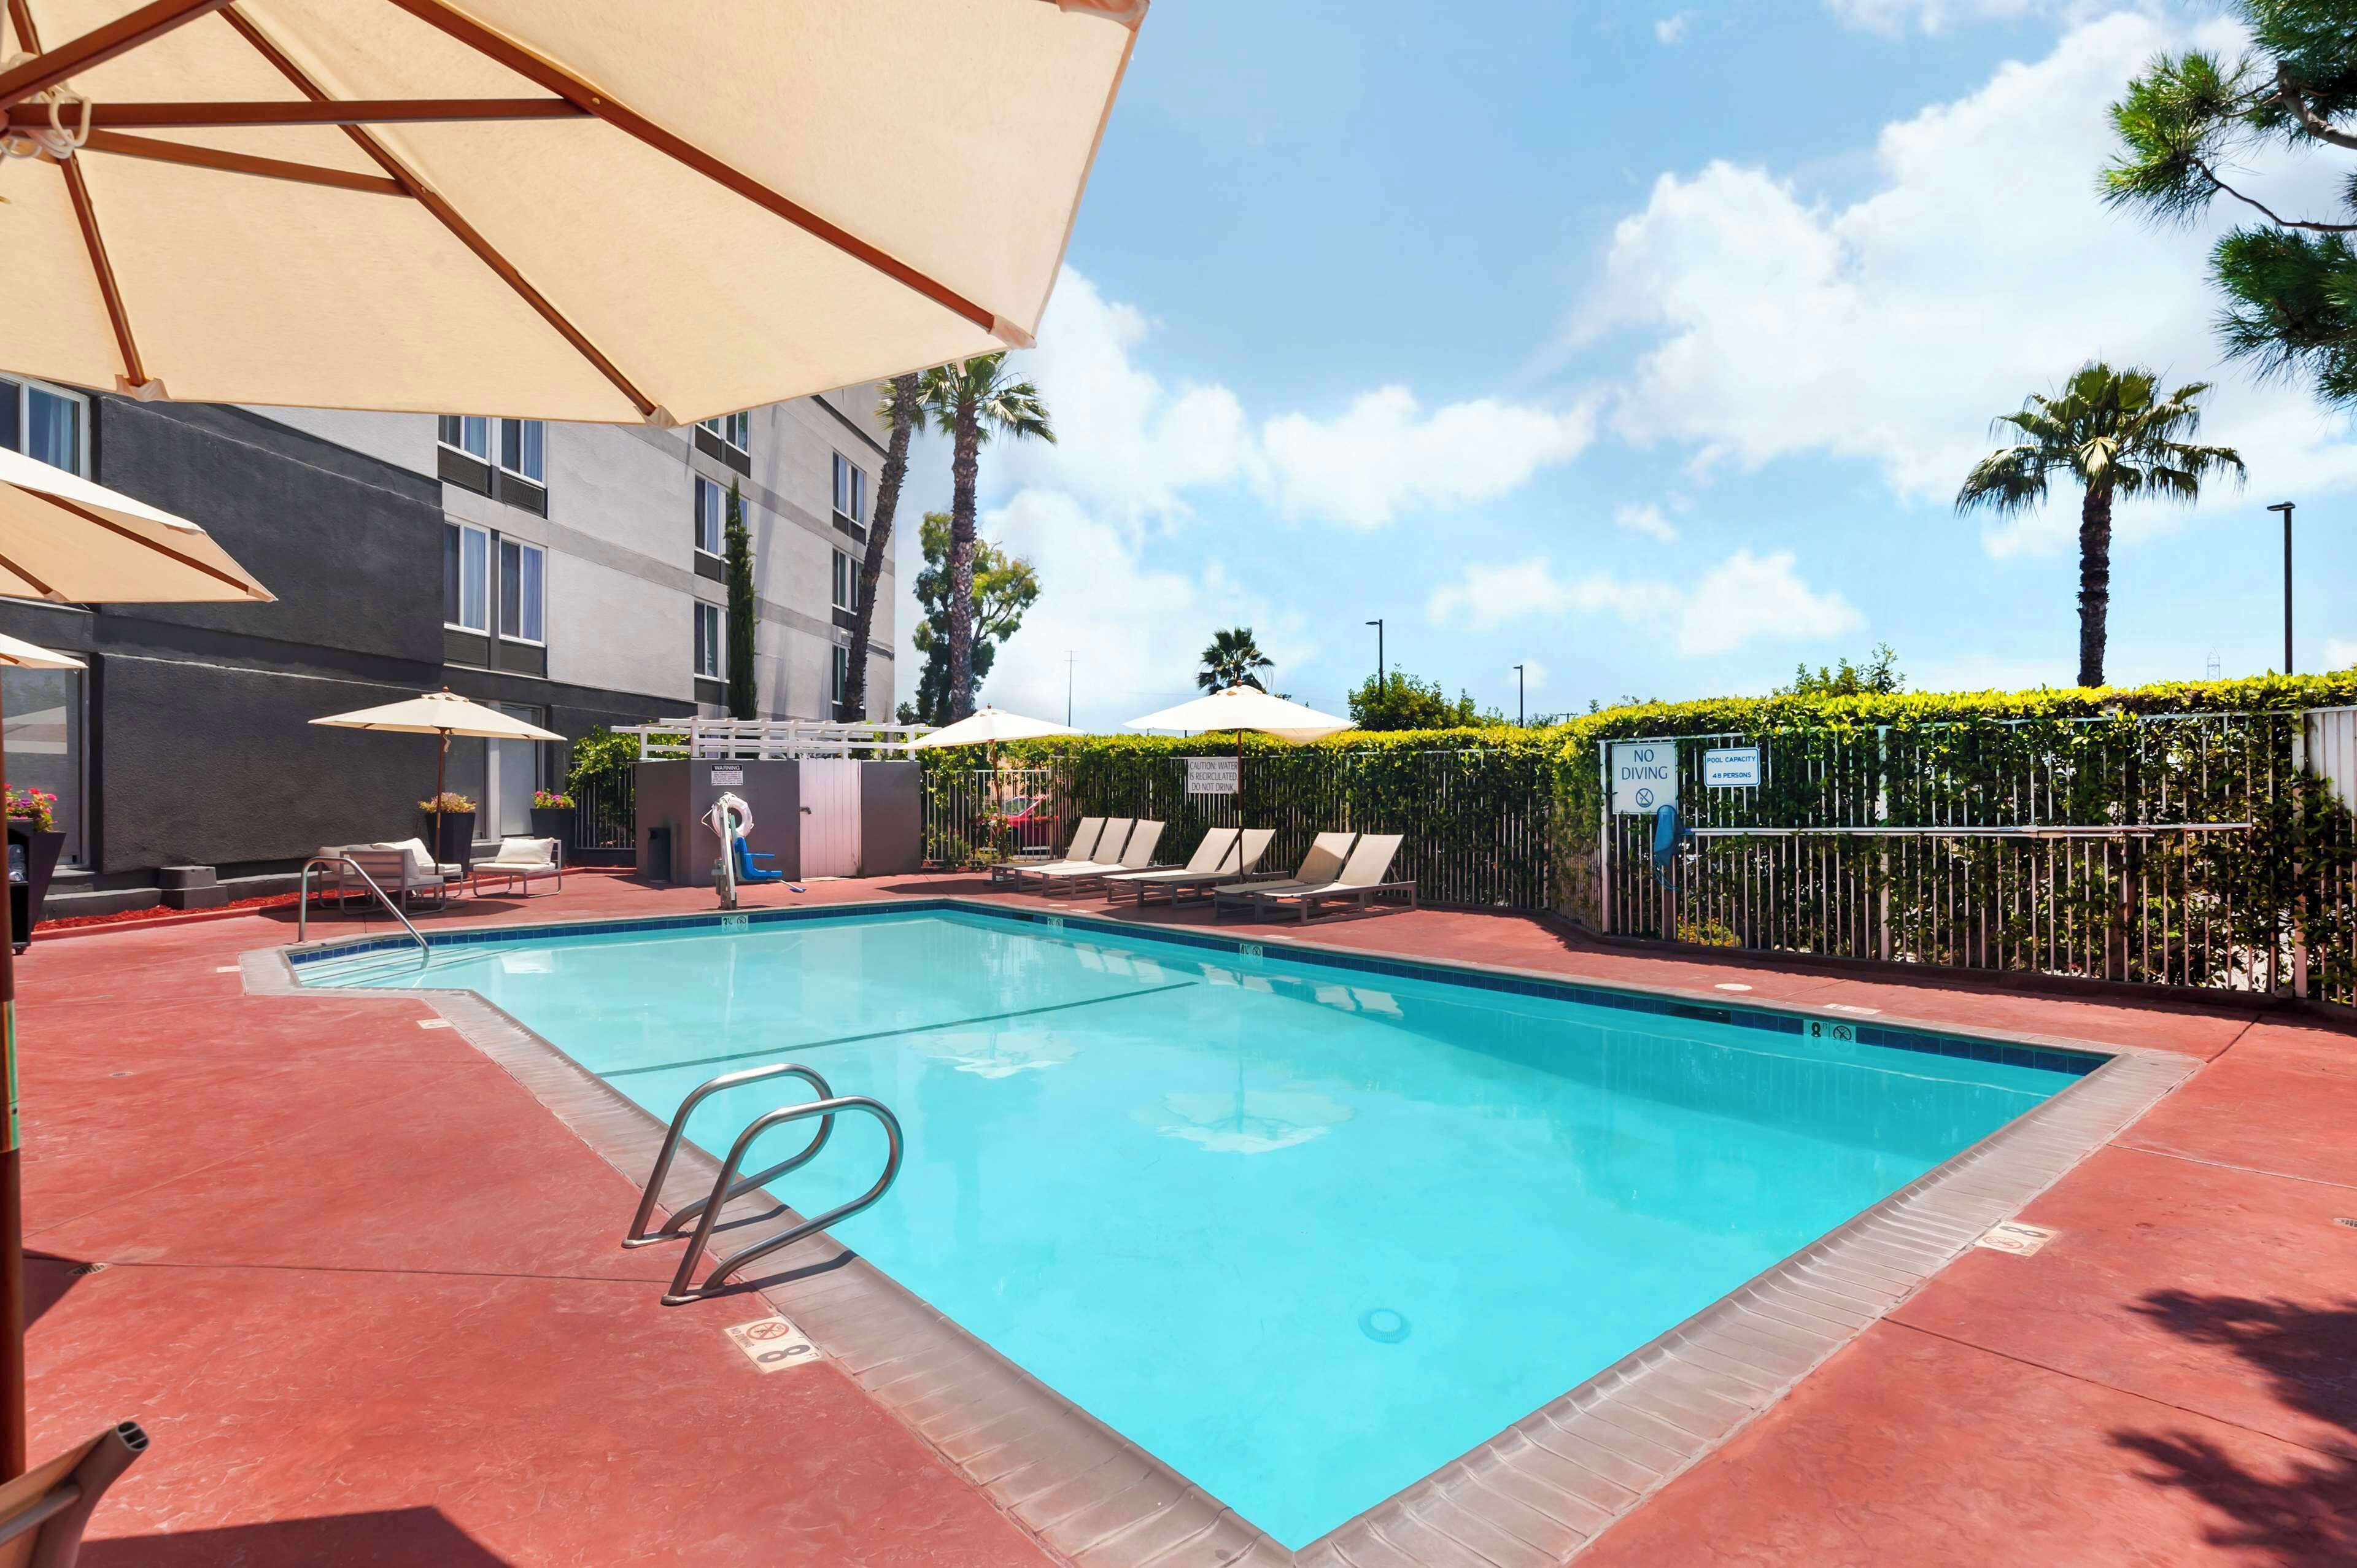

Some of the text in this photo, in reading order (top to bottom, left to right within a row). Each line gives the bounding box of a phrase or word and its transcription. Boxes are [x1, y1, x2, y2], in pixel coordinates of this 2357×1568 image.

[1634, 749, 1654, 762] NO
[1218, 762, 1238, 770] WATER
[1189, 772, 1194, 781] IS
[1622, 766, 1668, 780] DIVING
[1191, 782, 1201, 791] DO
[1202, 782, 1215, 791] NOT
[1999, 1226, 2048, 1238] 8
[756, 1344, 811, 1363] 8
